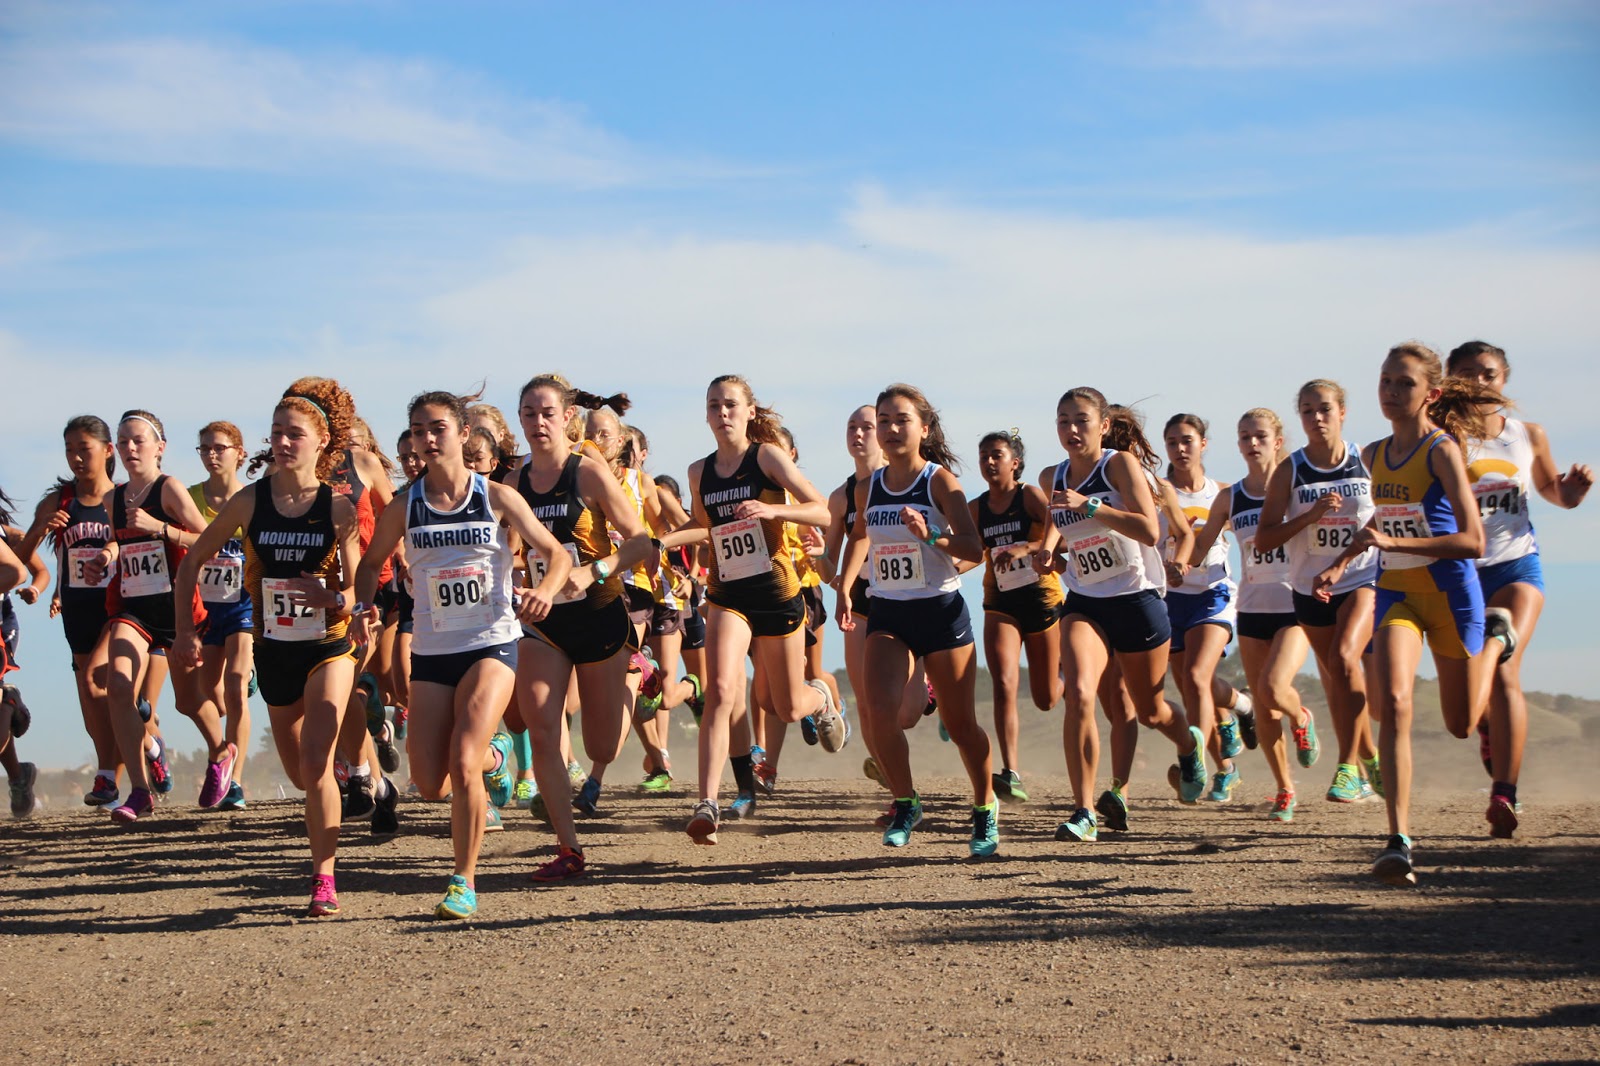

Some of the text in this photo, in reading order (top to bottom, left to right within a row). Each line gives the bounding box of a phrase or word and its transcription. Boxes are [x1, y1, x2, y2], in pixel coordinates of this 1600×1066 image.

[704, 485, 751, 506] MOUNTAIN
[1371, 483, 1409, 501] AGLES
[533, 504, 568, 518] UNTAIN
[866, 510, 929, 526] WARRIS
[63, 521, 111, 549] LYNBROO
[411, 527, 491, 549] WARRIORS
[984, 521, 1021, 538] MOUNTAIN
[1317, 528, 1352, 548] 982
[1382, 520, 1419, 538] 565
[258, 531, 324, 547] MOUNTAIN
[721, 532, 756, 560] 509
[995, 535, 1013, 546] VIEW
[274, 548, 306, 562] VIEW
[1078, 547, 1113, 575] 988
[124, 553, 162, 577] 1042
[880, 556, 913, 580] 983
[203, 567, 233, 586] 774
[438, 579, 480, 607] 980
